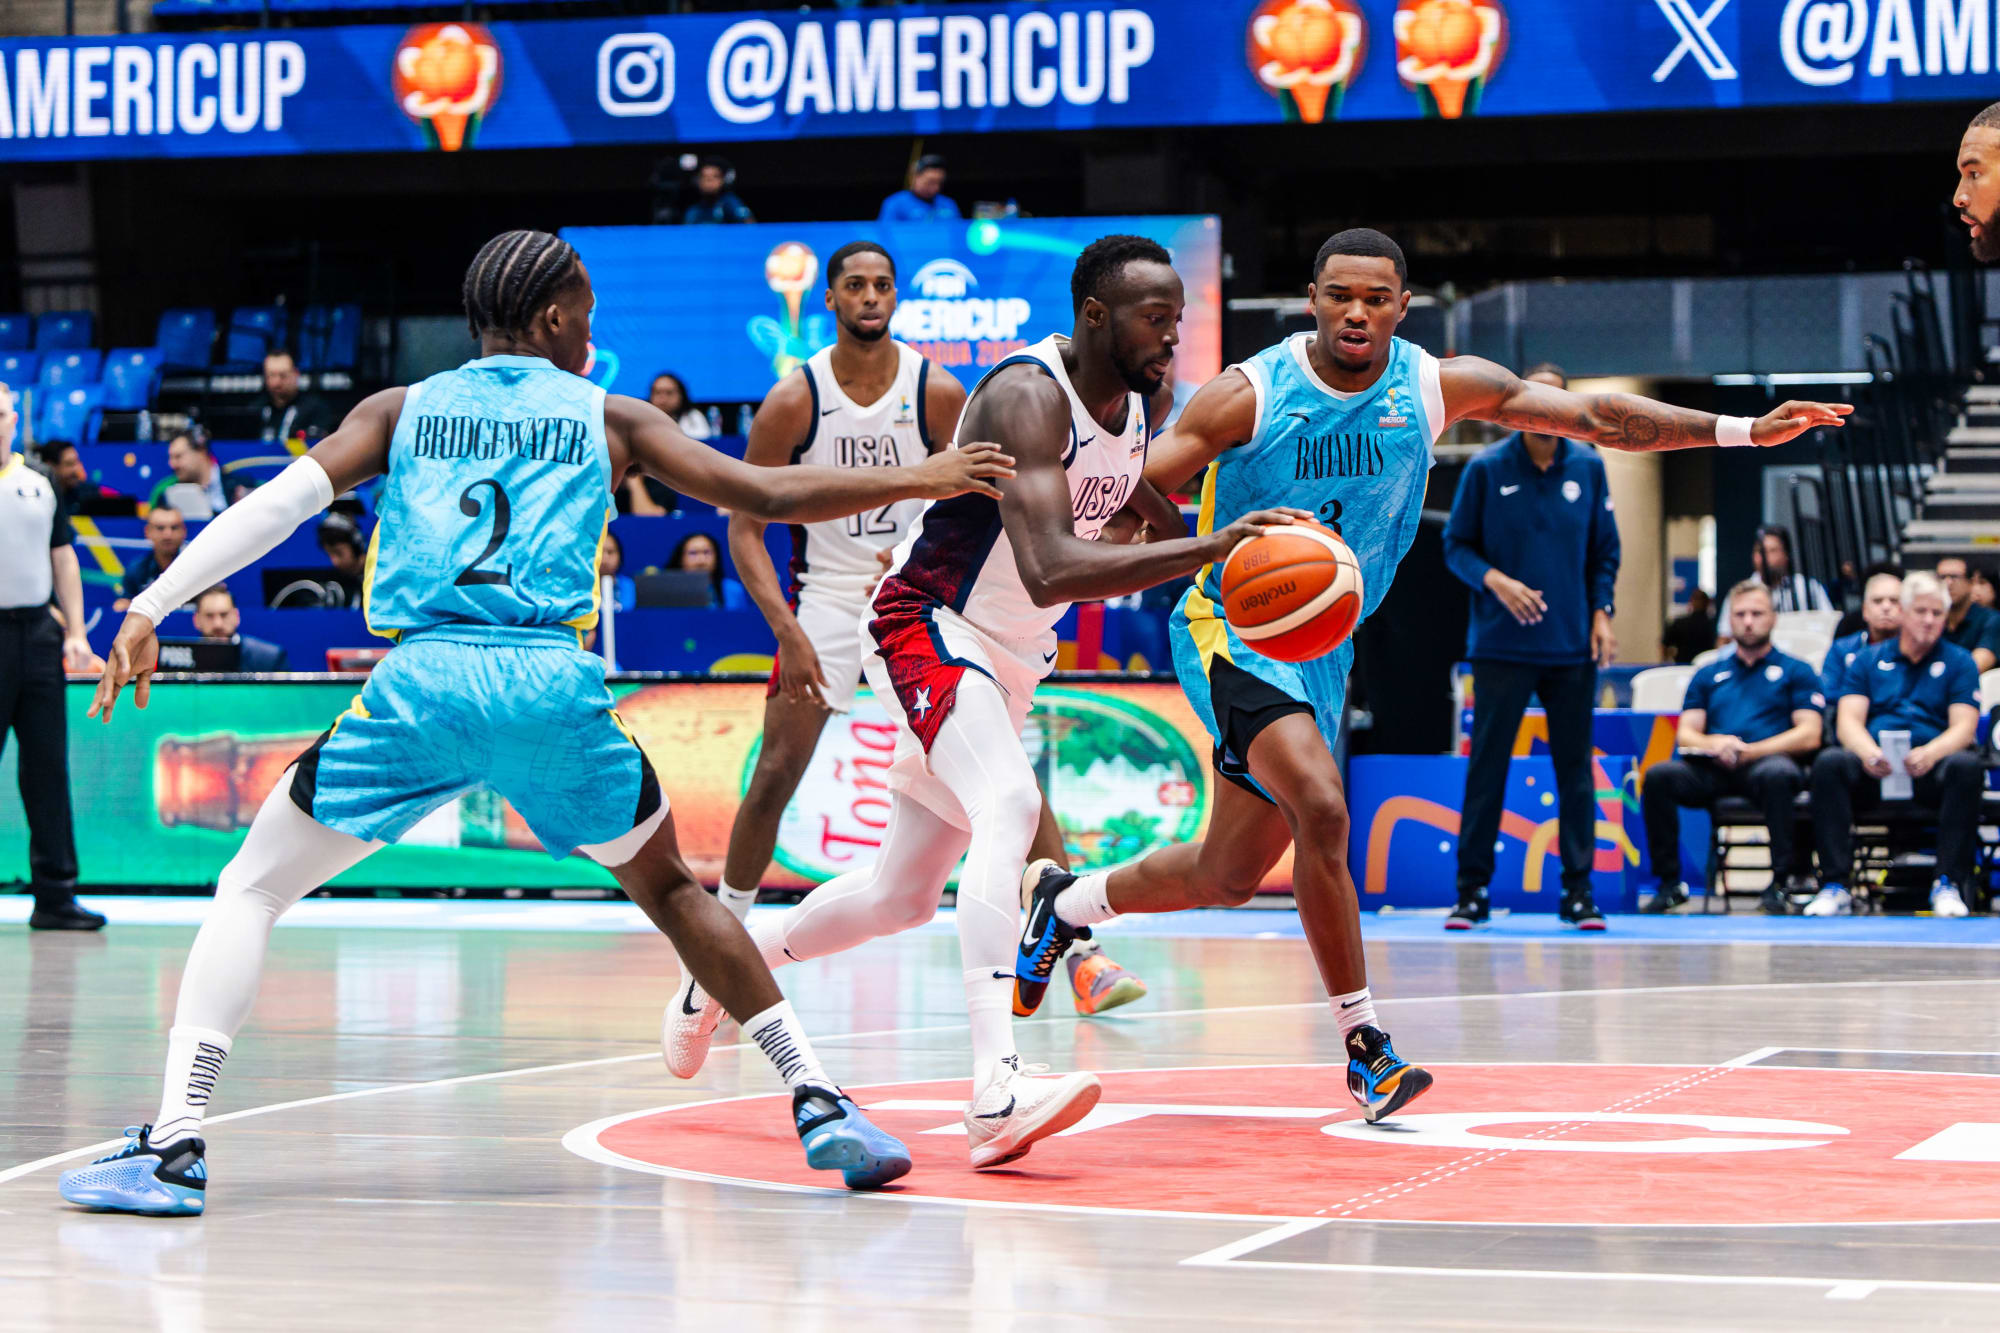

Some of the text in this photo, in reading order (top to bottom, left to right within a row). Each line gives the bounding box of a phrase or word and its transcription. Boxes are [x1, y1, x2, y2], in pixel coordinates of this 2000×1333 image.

[706, 9, 1156, 124] @AMERICUP
[1780, 0, 2000, 86] @AM
[888, 297, 1031, 341] MERICUP
[413, 415, 587, 466] BRIDGEWATER
[835, 435, 900, 468] USA
[1294, 432, 1384, 480] BAHAMAS
[1072, 474, 1129, 520] USA
[454, 478, 513, 587] 2
[1243, 551, 1271, 571] FIBA
[1240, 580, 1297, 611] molten
[186, 1041, 228, 1106] BAHAMAS
[751, 1018, 808, 1085] BAHAMAS
